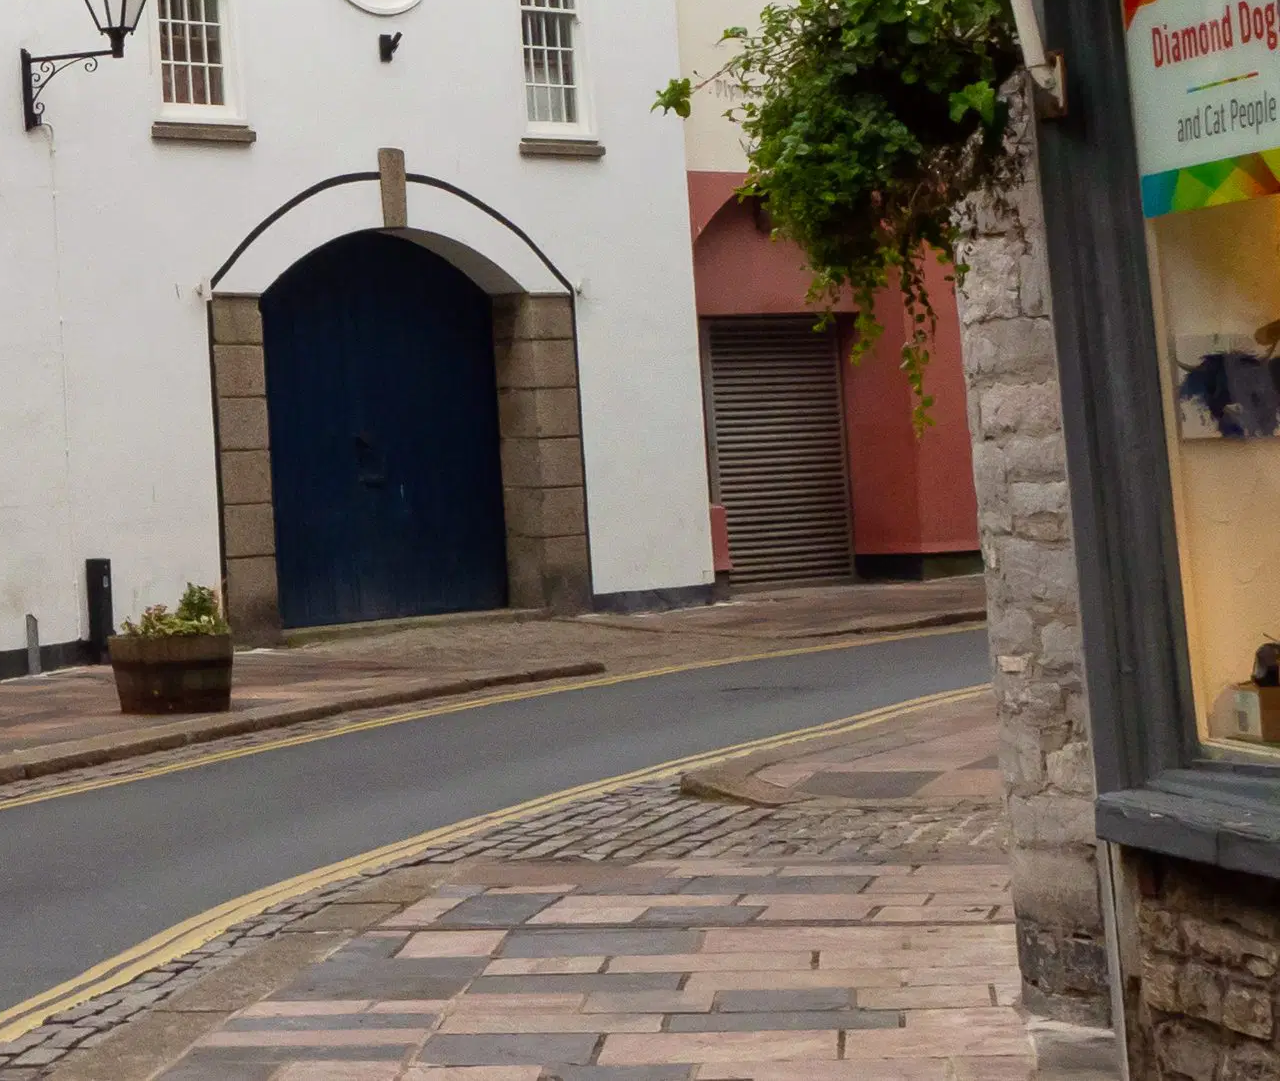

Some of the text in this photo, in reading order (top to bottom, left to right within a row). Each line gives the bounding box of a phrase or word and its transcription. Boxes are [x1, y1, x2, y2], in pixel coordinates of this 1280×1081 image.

[1151, 0, 1280, 69] Diamond Dog
[1177, 90, 1277, 143] and Cat People
